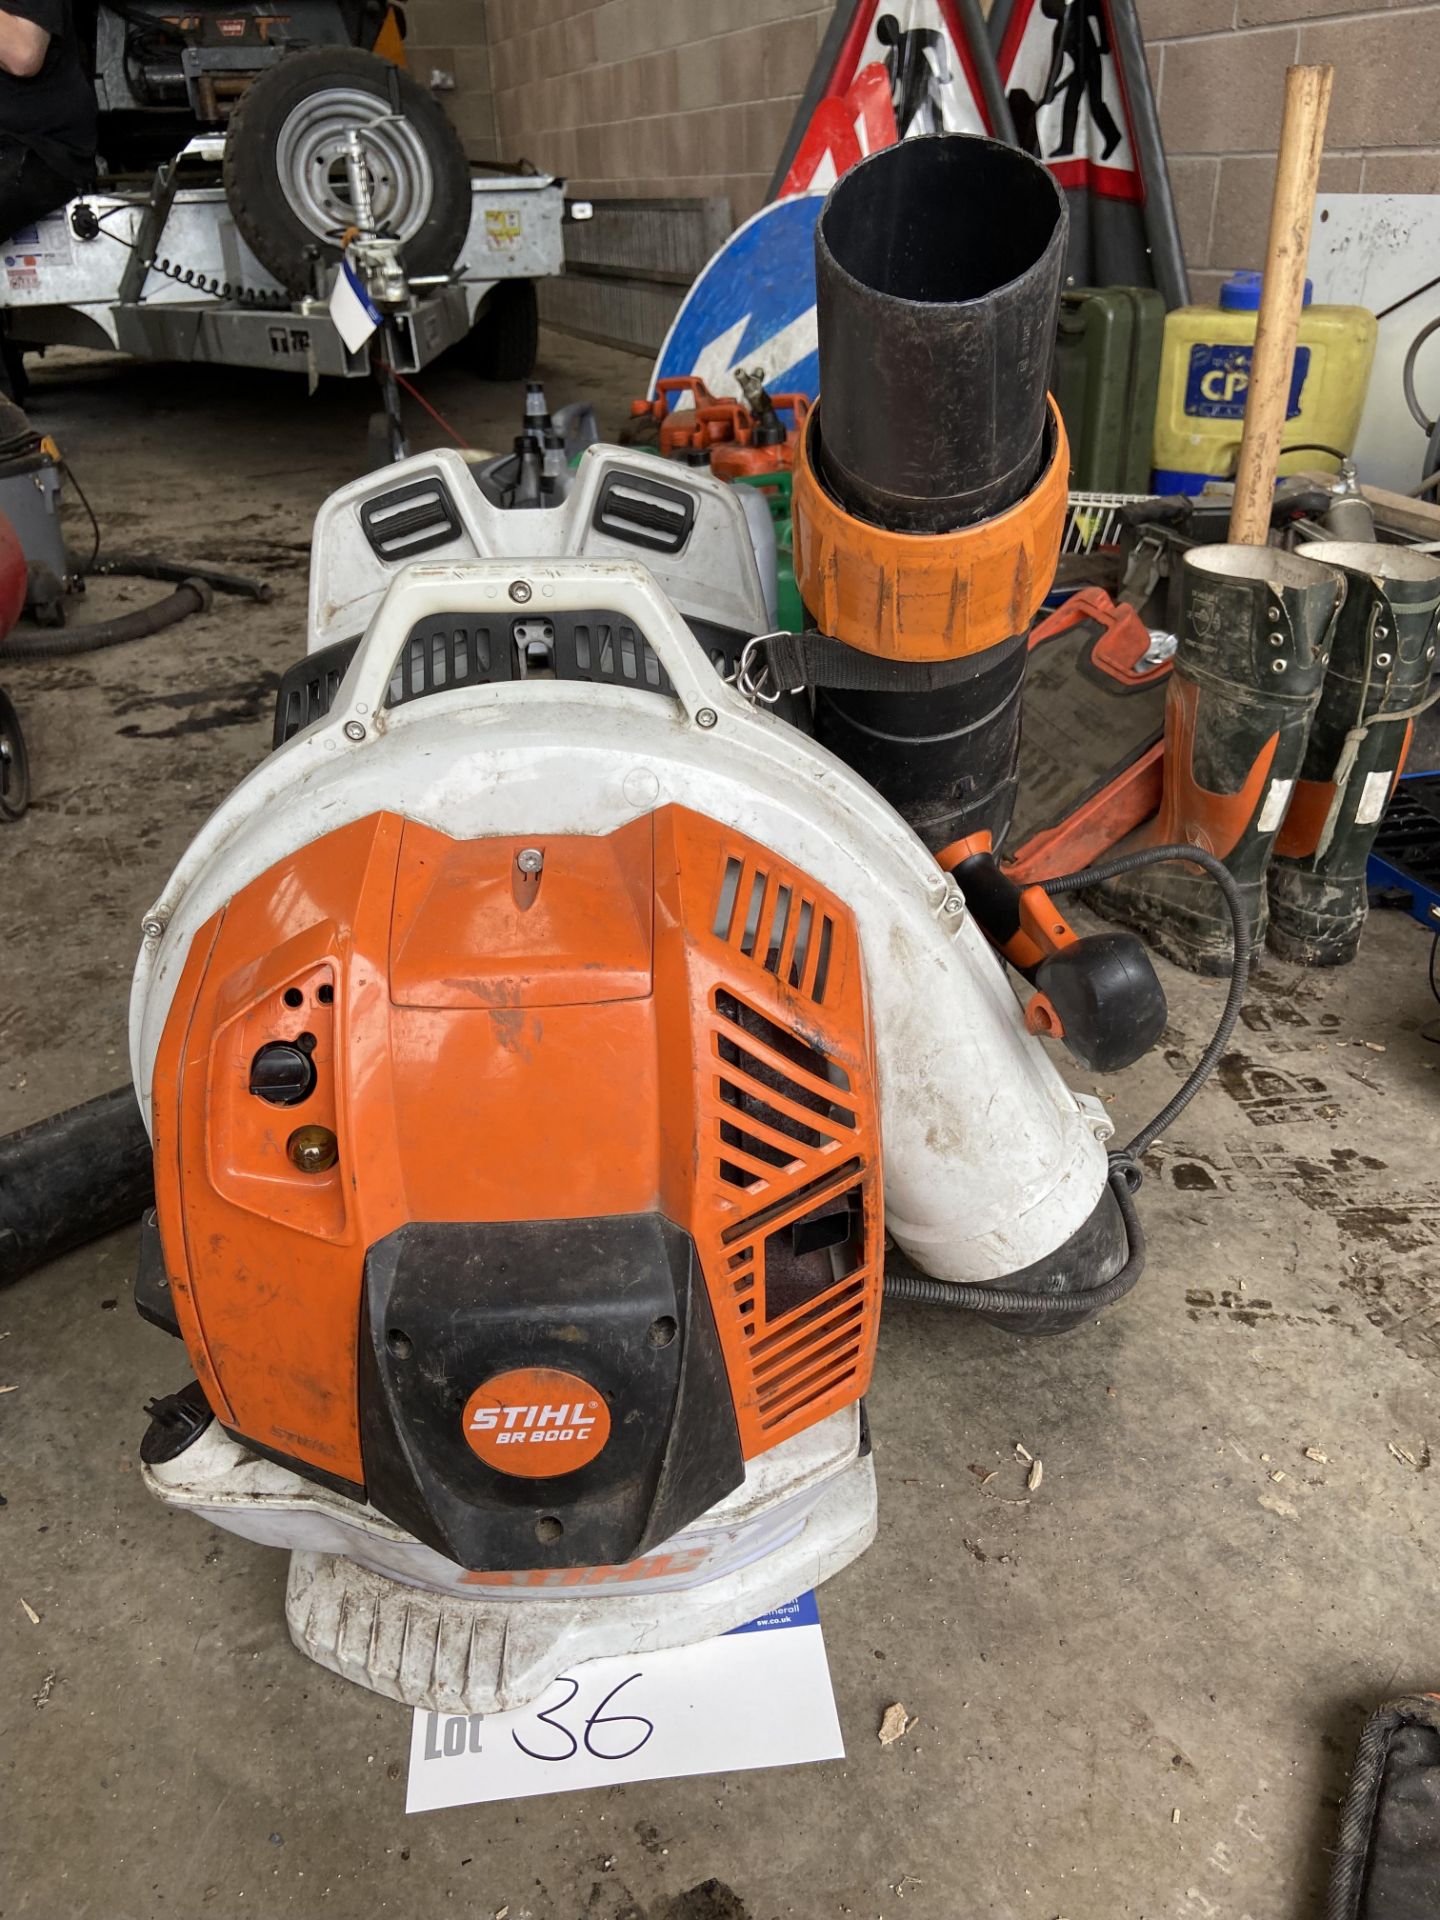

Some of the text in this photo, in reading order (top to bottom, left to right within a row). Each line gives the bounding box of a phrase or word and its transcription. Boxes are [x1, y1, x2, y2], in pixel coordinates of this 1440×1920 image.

[470, 1403, 597, 1430] STIHL
[496, 1428, 592, 1444] BR 800 C
[512, 1673, 654, 1761] 36
